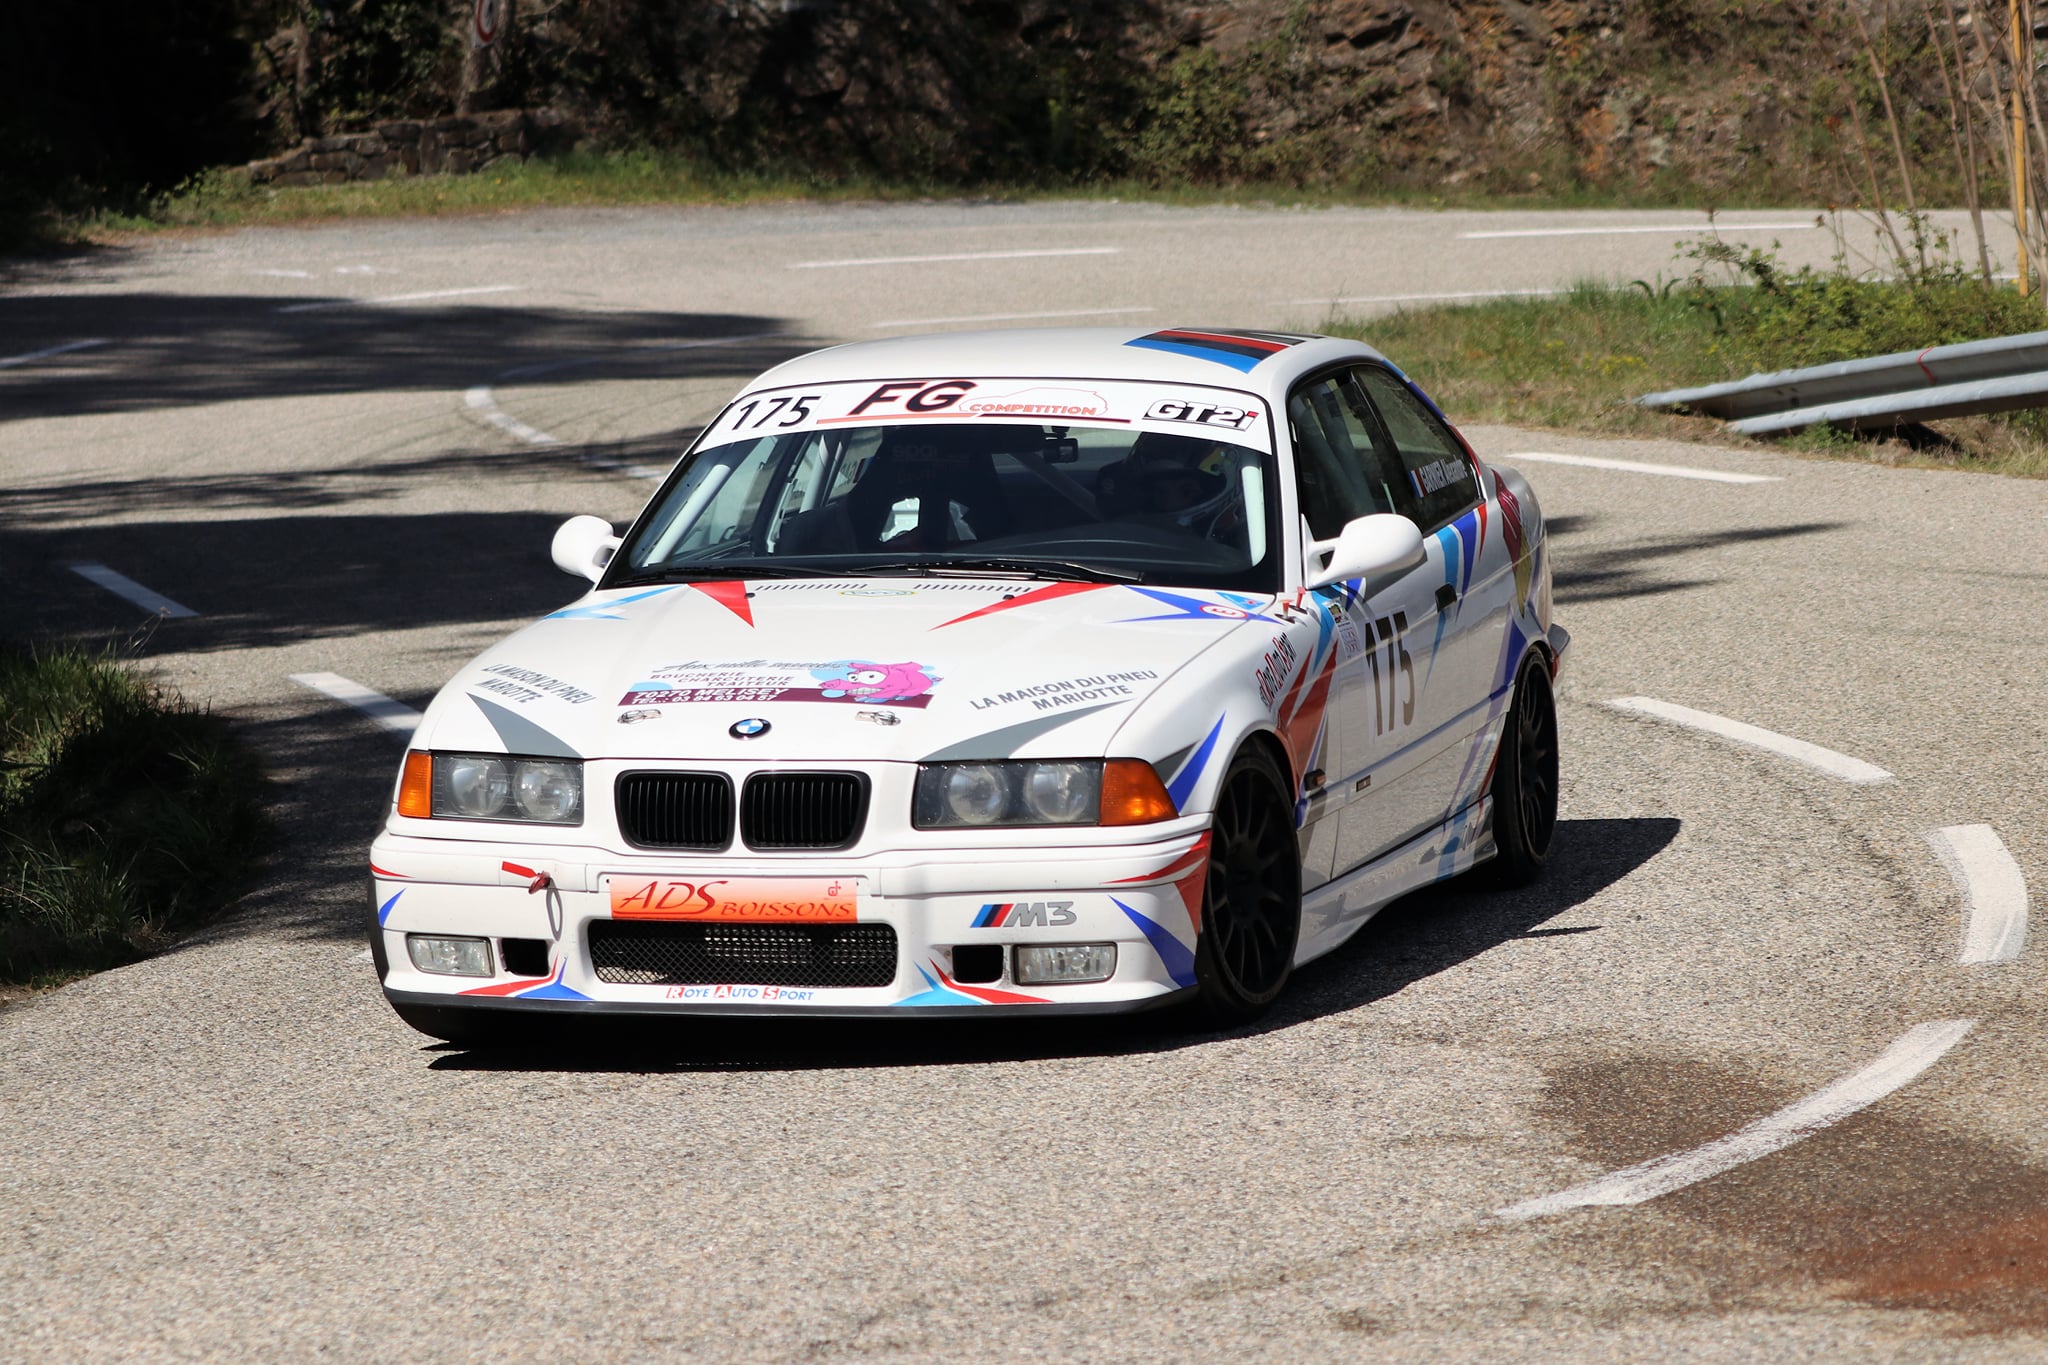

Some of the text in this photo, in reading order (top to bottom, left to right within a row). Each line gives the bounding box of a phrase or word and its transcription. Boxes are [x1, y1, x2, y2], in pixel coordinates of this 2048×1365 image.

[732, 396, 822, 431] 175
[845, 380, 1098, 417] FG COMPETITION
[1142, 398, 1257, 431] GT2i
[650, 671, 746, 680] BOUCHERIE
[1364, 609, 1416, 737] 175
[634, 689, 691, 700] 70270
[672, 696, 691, 704] 03
[969, 669, 1159, 711] LA MAISON DU PNEU
[1031, 684, 1134, 711] MARIOTTE
[613, 880, 853, 917] ADS BOISSONS
[1002, 901, 1078, 928] M3
[665, 985, 815, 1001] ROYE AUTO SPORT
